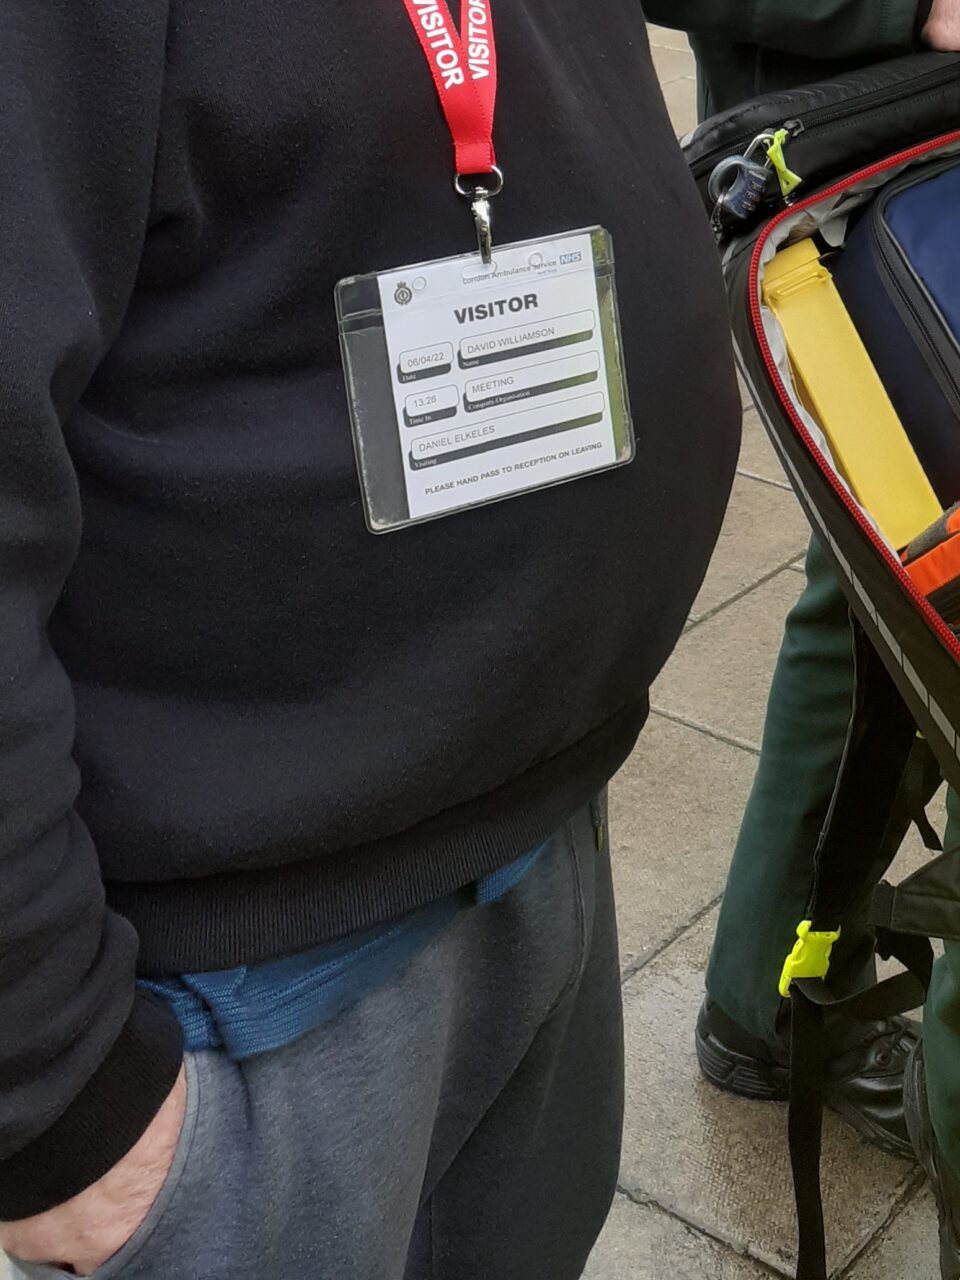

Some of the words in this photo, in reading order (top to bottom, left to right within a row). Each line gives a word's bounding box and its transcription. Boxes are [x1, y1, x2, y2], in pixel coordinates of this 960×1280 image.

[462, 273, 491, 285] London
[492, 265, 531, 279] Ambulance
[560, 251, 582, 265] NHS
[453, 293, 539, 324] VISITOR
[467, 340, 496, 354] DAVID
[499, 327, 556, 346] WILLIAMSON
[407, 352, 445, 368] 06/04/22
[471, 376, 514, 394] MEETING
[418, 437, 452, 453] DANIEL
[454, 425, 496, 444] ELKELES
[425, 480, 455, 496] PLEASE
[456, 475, 479, 488] HAND
[480, 469, 501, 481] PASS
[502, 465, 513, 475] TO
[514, 454, 557, 471] RECEPTION
[558, 450, 570, 460] ON
[571, 441, 603, 457] LEAVING
